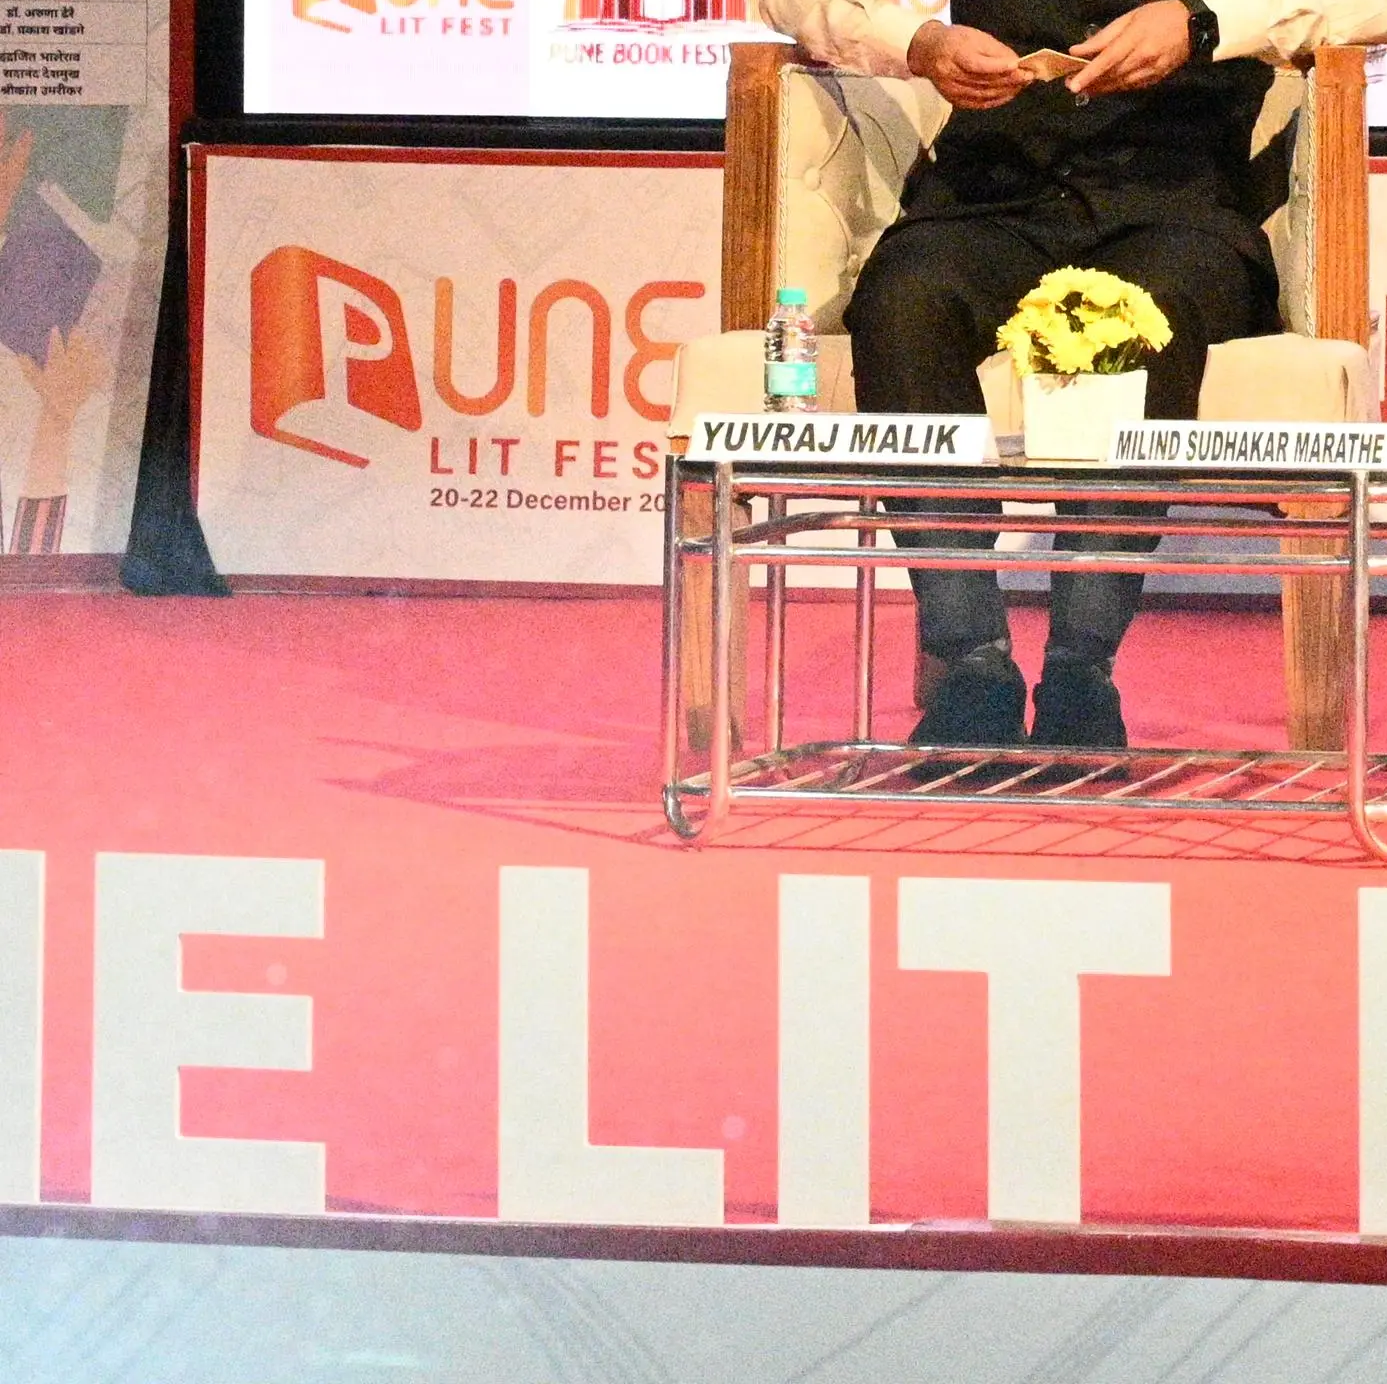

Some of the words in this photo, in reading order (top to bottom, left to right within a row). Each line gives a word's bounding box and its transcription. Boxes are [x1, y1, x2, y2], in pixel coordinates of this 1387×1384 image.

[380, 17, 425, 36] LIT
[441, 17, 511, 36] FEST
[251, 246, 706, 422] PUNE
[702, 421, 842, 456] YUVRAJ
[848, 423, 962, 456] MALIK
[1115, 430, 1182, 463] MILIND
[1186, 430, 1290, 465] SUDHAKAR
[1292, 432, 1384, 465] MARATHE
[430, 437, 521, 477] LIT
[554, 440, 660, 480] FES
[430, 488, 499, 509] 20-22
[506, 489, 632, 514] December
[639, 492, 666, 514] 20
[498, 866, 1172, 1229] LIT
